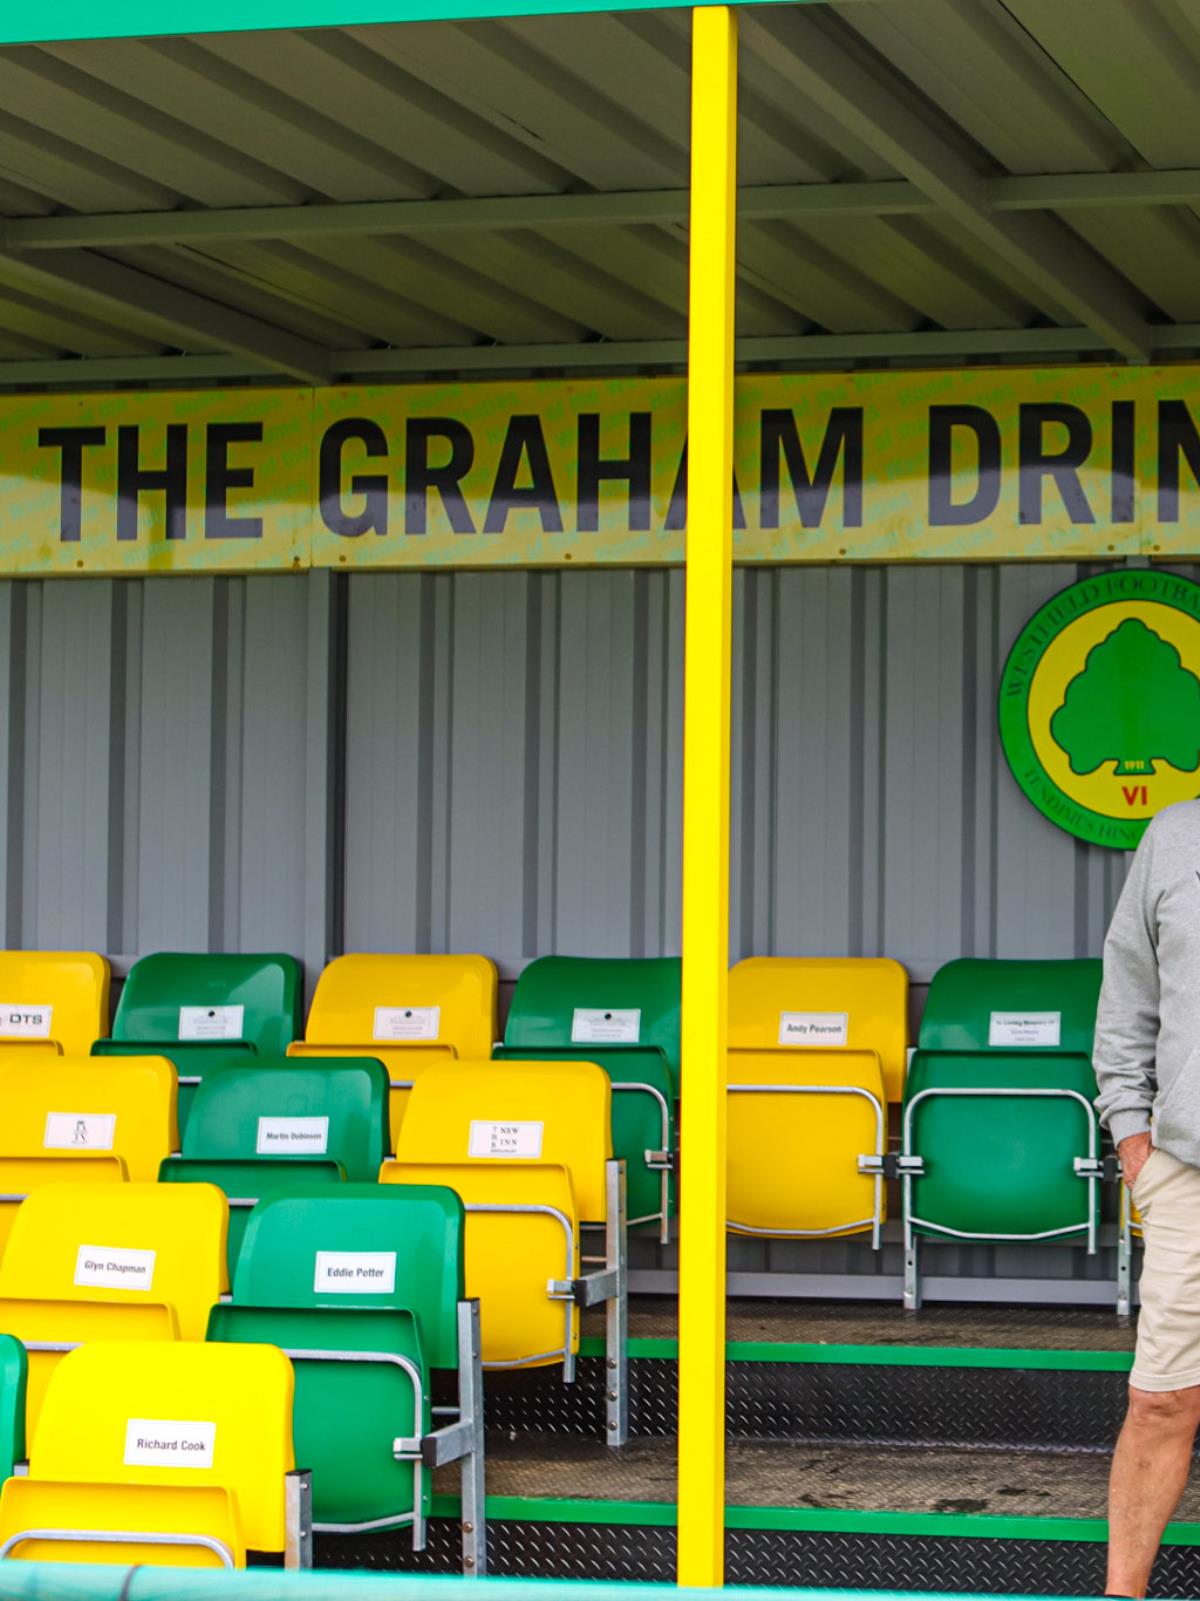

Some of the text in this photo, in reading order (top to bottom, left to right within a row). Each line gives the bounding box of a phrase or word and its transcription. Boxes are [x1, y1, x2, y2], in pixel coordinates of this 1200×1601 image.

[38, 421, 263, 542] THE
[1123, 760, 1145, 770] 1911
[1122, 785, 1148, 806] VI
[84, 1259, 146, 1274] Glyn Chapman
[327, 1267, 384, 1278] Eddie Potter
[136, 1438, 206, 1452] Richard Cook
